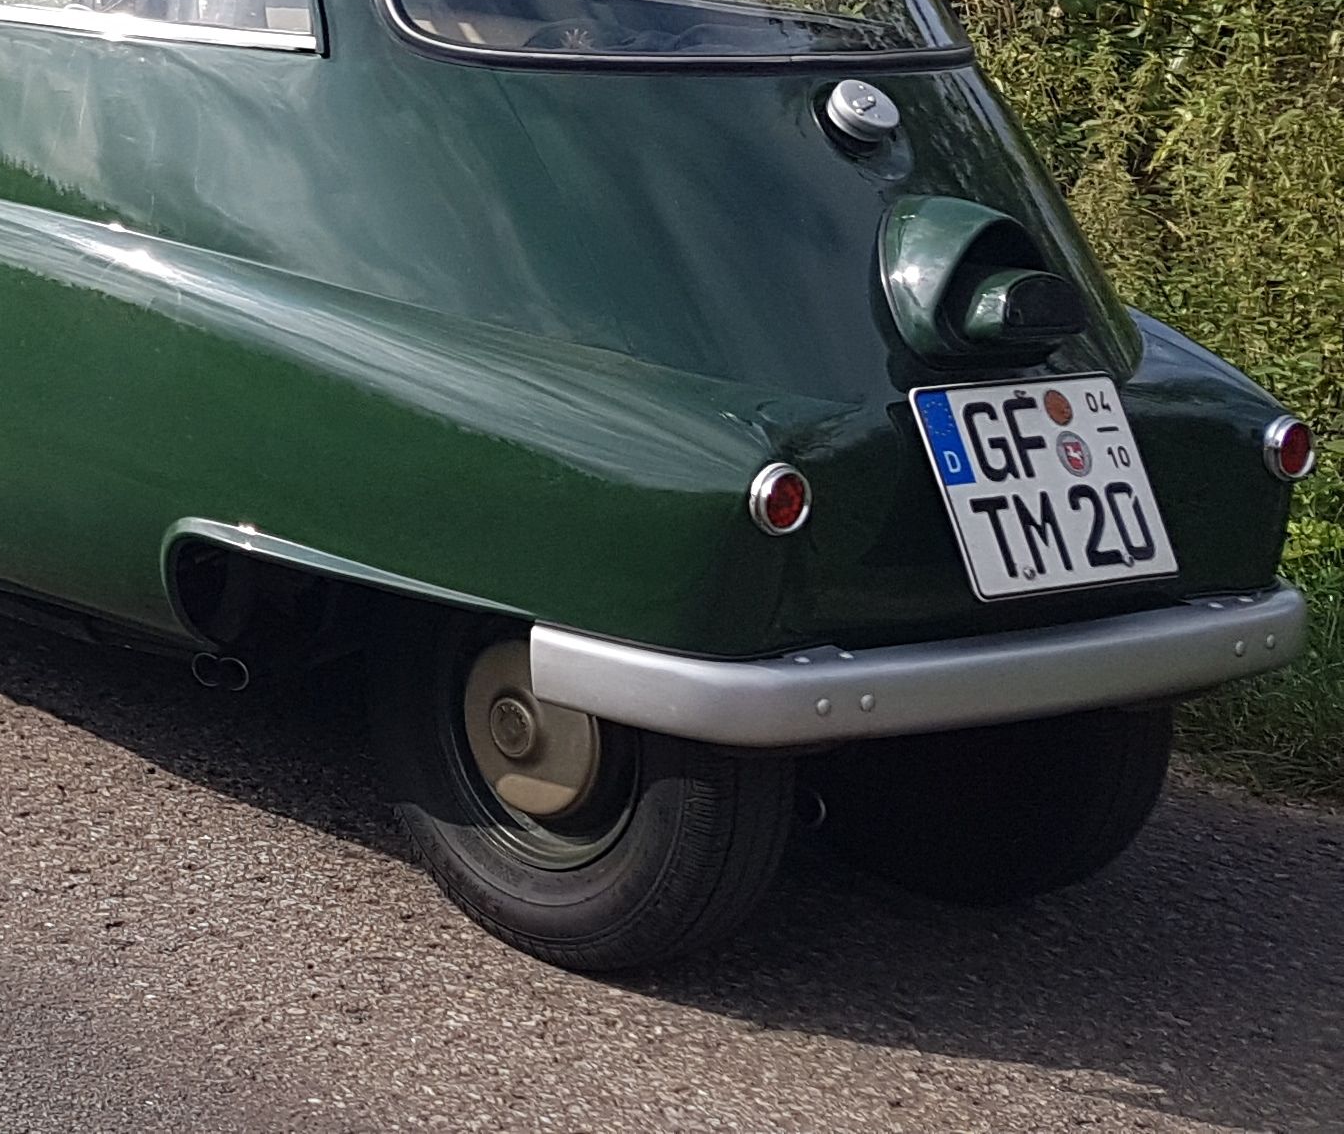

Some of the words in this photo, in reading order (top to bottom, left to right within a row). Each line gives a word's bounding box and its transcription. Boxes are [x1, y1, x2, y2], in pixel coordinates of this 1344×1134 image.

[945, 450, 962, 473] D
[962, 396, 1046, 482] GF
[1085, 390, 1112, 412] 04
[1107, 445, 1131, 469] 10
[970, 490, 1074, 578] TM
[1067, 481, 1156, 566] 20
